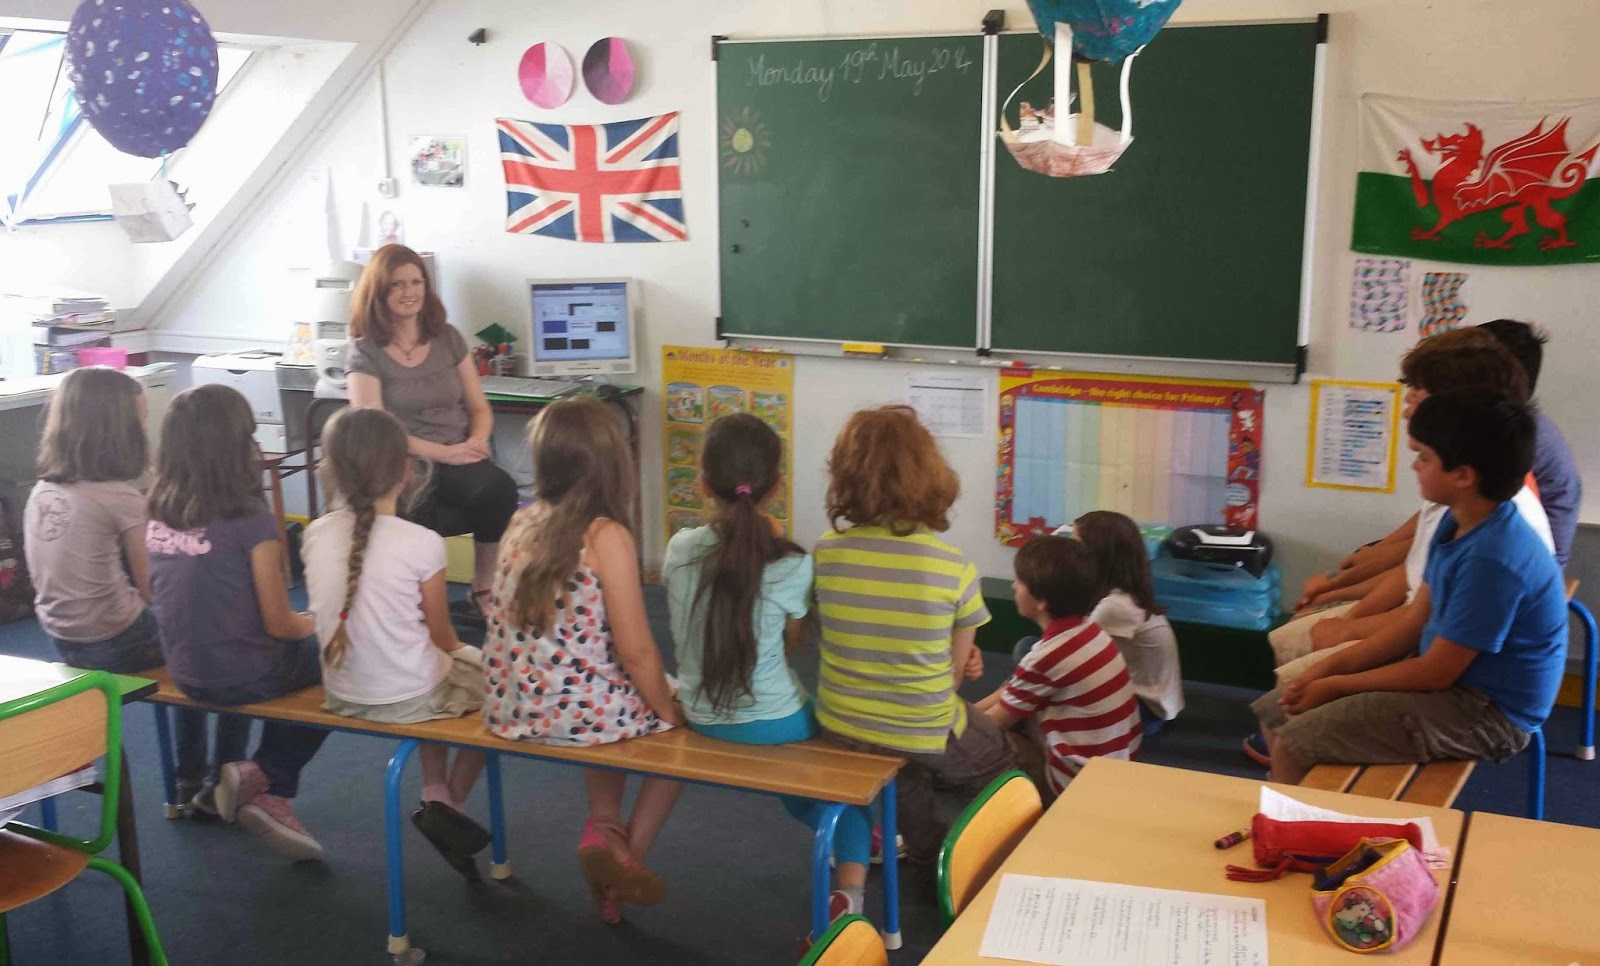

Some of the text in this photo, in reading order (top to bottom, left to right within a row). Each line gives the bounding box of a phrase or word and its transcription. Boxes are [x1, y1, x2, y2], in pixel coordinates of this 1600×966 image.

[746, 54, 834, 102] Monday
[877, 47, 926, 96] May
[678, 350, 776, 368] Months of the Year
[1032, 384, 1083, 397] Cambridge
[1089, 387, 1106, 397] the
[1106, 388, 1132, 401] right
[1132, 390, 1163, 401] choice
[1164, 392, 1180, 402] for
[1180, 392, 1226, 406] Primary!
